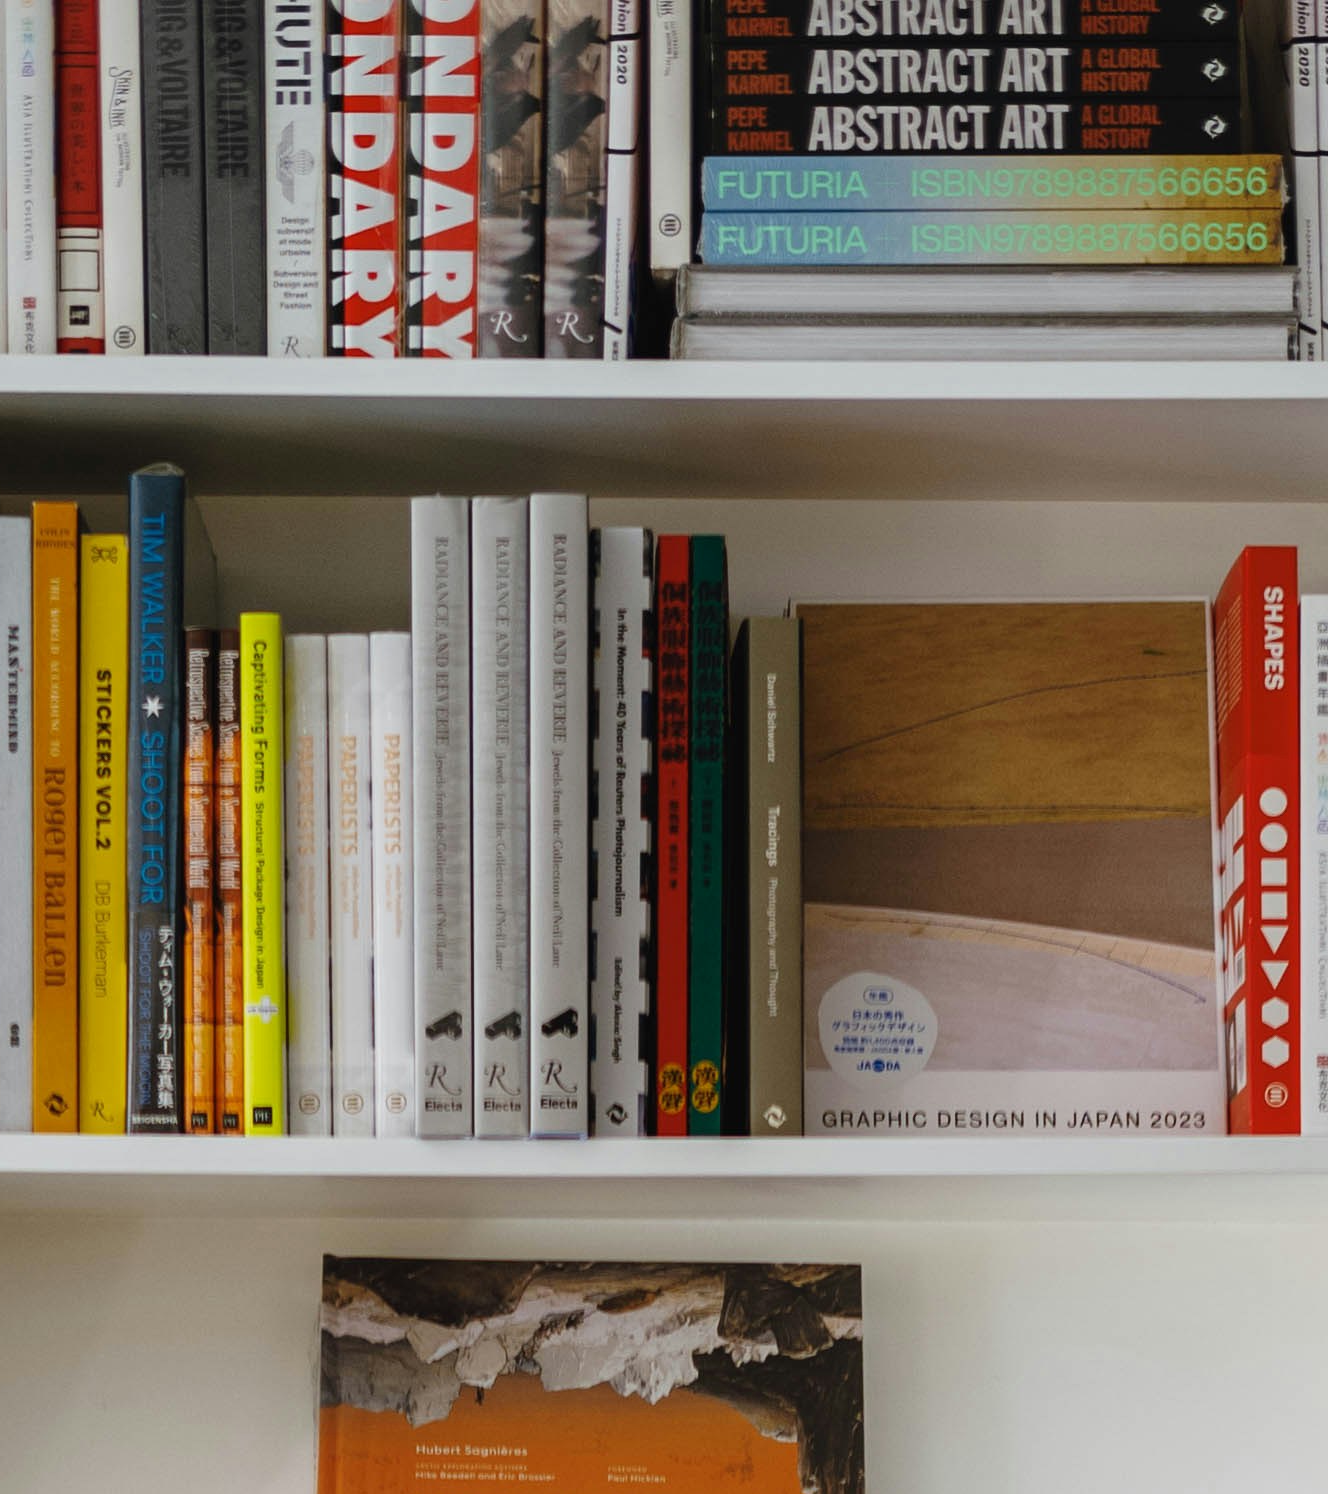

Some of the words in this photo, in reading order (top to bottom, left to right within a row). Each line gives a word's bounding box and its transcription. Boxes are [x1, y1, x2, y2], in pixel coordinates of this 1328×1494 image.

[727, 106, 767, 128] PEPE
[808, 105, 990, 151] ABSTRACT
[999, 104, 1070, 149] ART
[1082, 106, 1092, 126] A
[1097, 106, 1161, 126] GLOBAL
[727, 130, 793, 152] KARMEL
[1082, 128, 1150, 150] HISTORY
[717, 171, 868, 200] FUTURIA
[140, 512, 164, 563] TIM
[140, 577, 164, 683] WALKER
[1264, 587, 1283, 692] SHAPES
[141, 730, 163, 833] SHOOT
[141, 839, 163, 905] FOR
[822, 1109, 927, 1131] GRAPHIC
[935, 1109, 1026, 1131] DESIGN
[1035, 1110, 1057, 1130] IN
[1066, 1110, 1142, 1130] JAPAN
[1150, 1110, 1207, 1130] 2023
